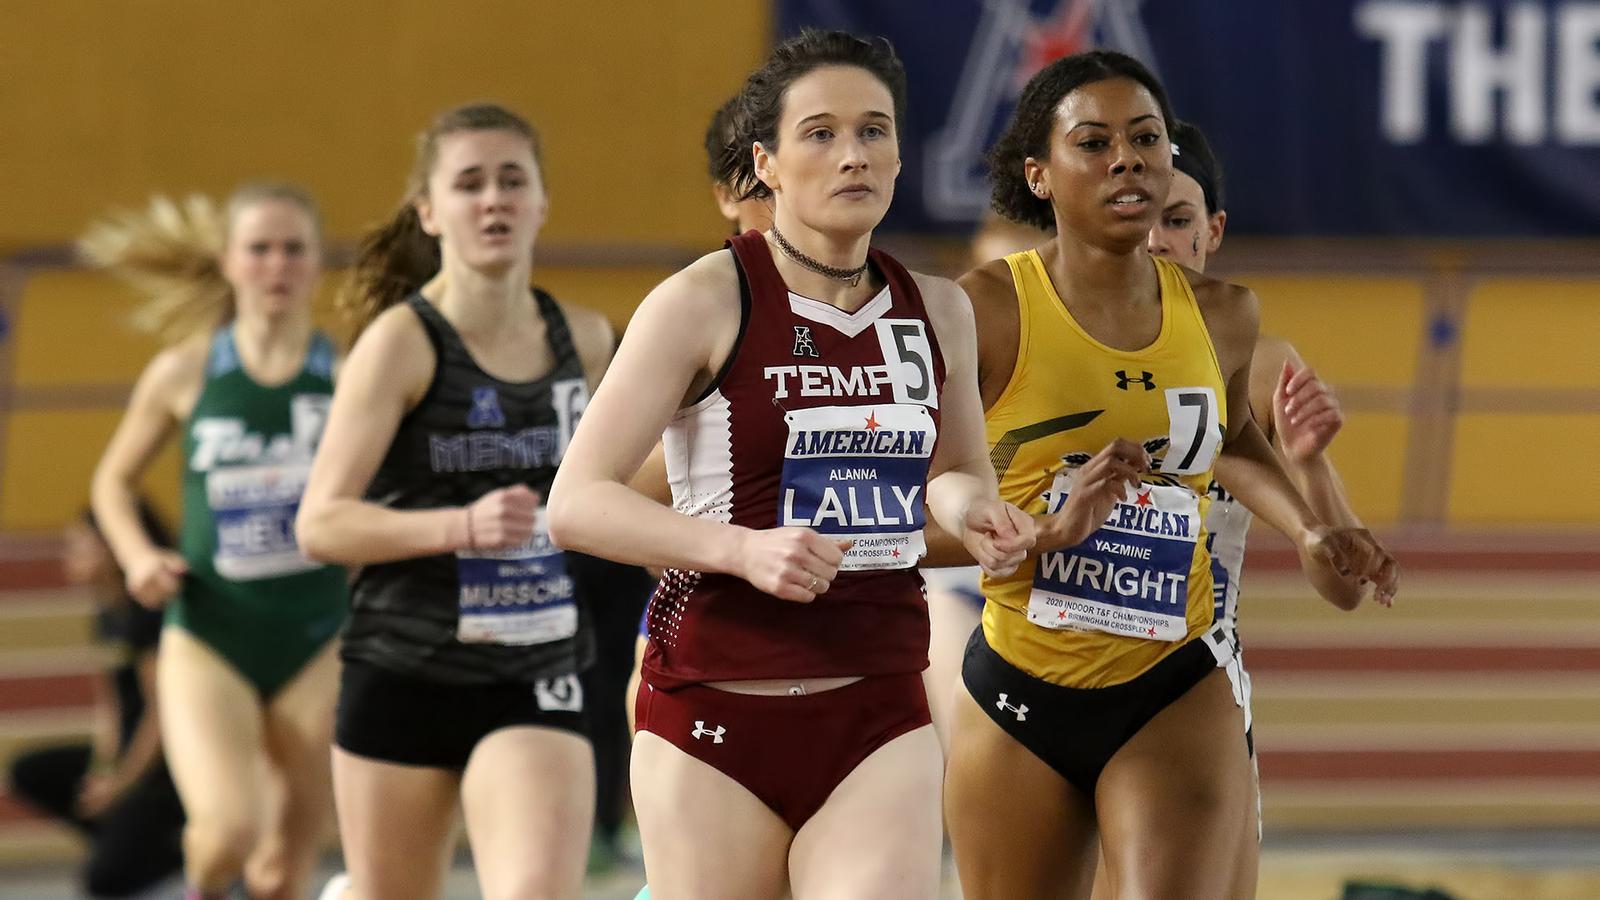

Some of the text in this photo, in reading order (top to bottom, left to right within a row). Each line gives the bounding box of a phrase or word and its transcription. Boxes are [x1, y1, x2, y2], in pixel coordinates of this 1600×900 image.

[891, 324, 930, 401] 5
[764, 364, 893, 399] TEMP
[791, 430, 926, 456] AMERICAN
[1177, 392, 1208, 470] 7
[829, 468, 877, 481] ALANNA
[783, 485, 921, 527] LALLY
[1095, 539, 1151, 560] YAZMINE
[1040, 551, 1187, 604] WRIGHT
[1046, 597, 1170, 629] 2020 INDOOR T&F CHAMPIONSHIPS
[1068, 613, 1110, 627] BIRMINGHAM
[1110, 621, 1146, 633] CROSSPLEX
